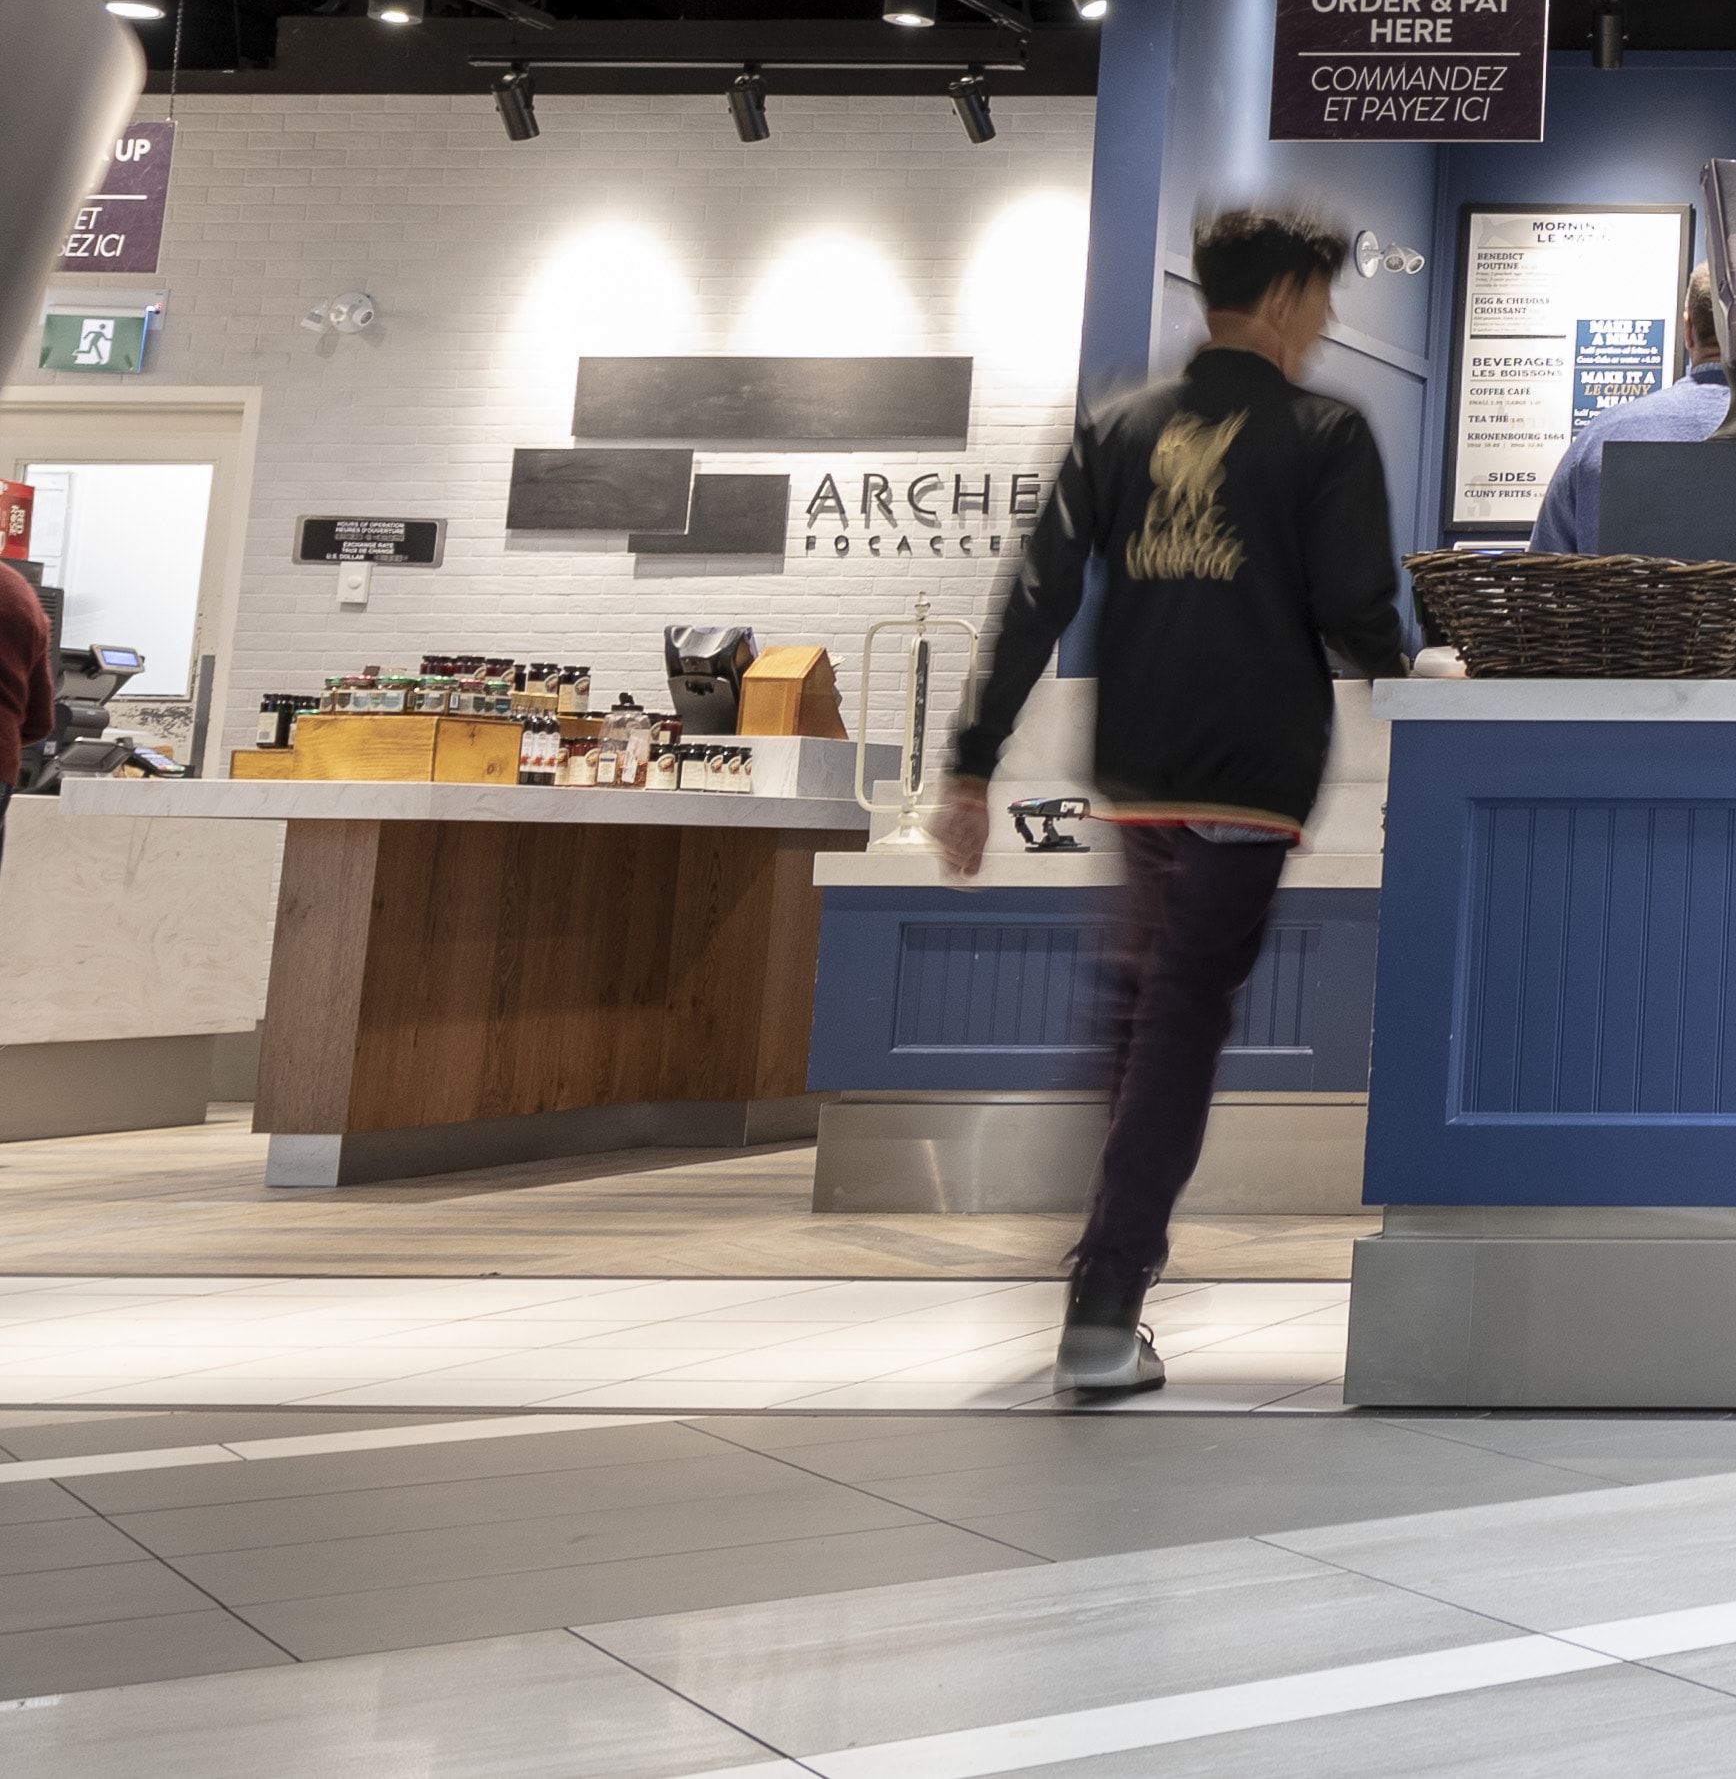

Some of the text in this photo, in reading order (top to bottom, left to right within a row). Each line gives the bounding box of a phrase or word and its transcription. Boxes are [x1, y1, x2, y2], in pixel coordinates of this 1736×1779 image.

[1370, 19, 1453, 43] HERE
[1311, 66, 1507, 91] COMMANDEZ
[1323, 97, 1490, 121] ET PAYEZ ICI
[115, 139, 151, 161] UP
[74, 207, 103, 230] ET
[1537, 234, 1555, 243] LE
[94, 234, 125, 257] ICI
[1477, 253, 1524, 261] BENEDICT
[1474, 297, 1494, 305] EGG
[1474, 307, 1527, 315] CROISSANT
[1472, 357, 1564, 366] BEVERAGES
[1500, 369, 1563, 377] BOISSONS
[1584, 384, 1651, 395] LE CLUNY
[1467, 432, 1540, 440] KRONENBOURG
[1488, 472, 1536, 481] SIDES
[805, 473, 1040, 515] ARCHE
[1464, 490, 1496, 498] CLUNY
